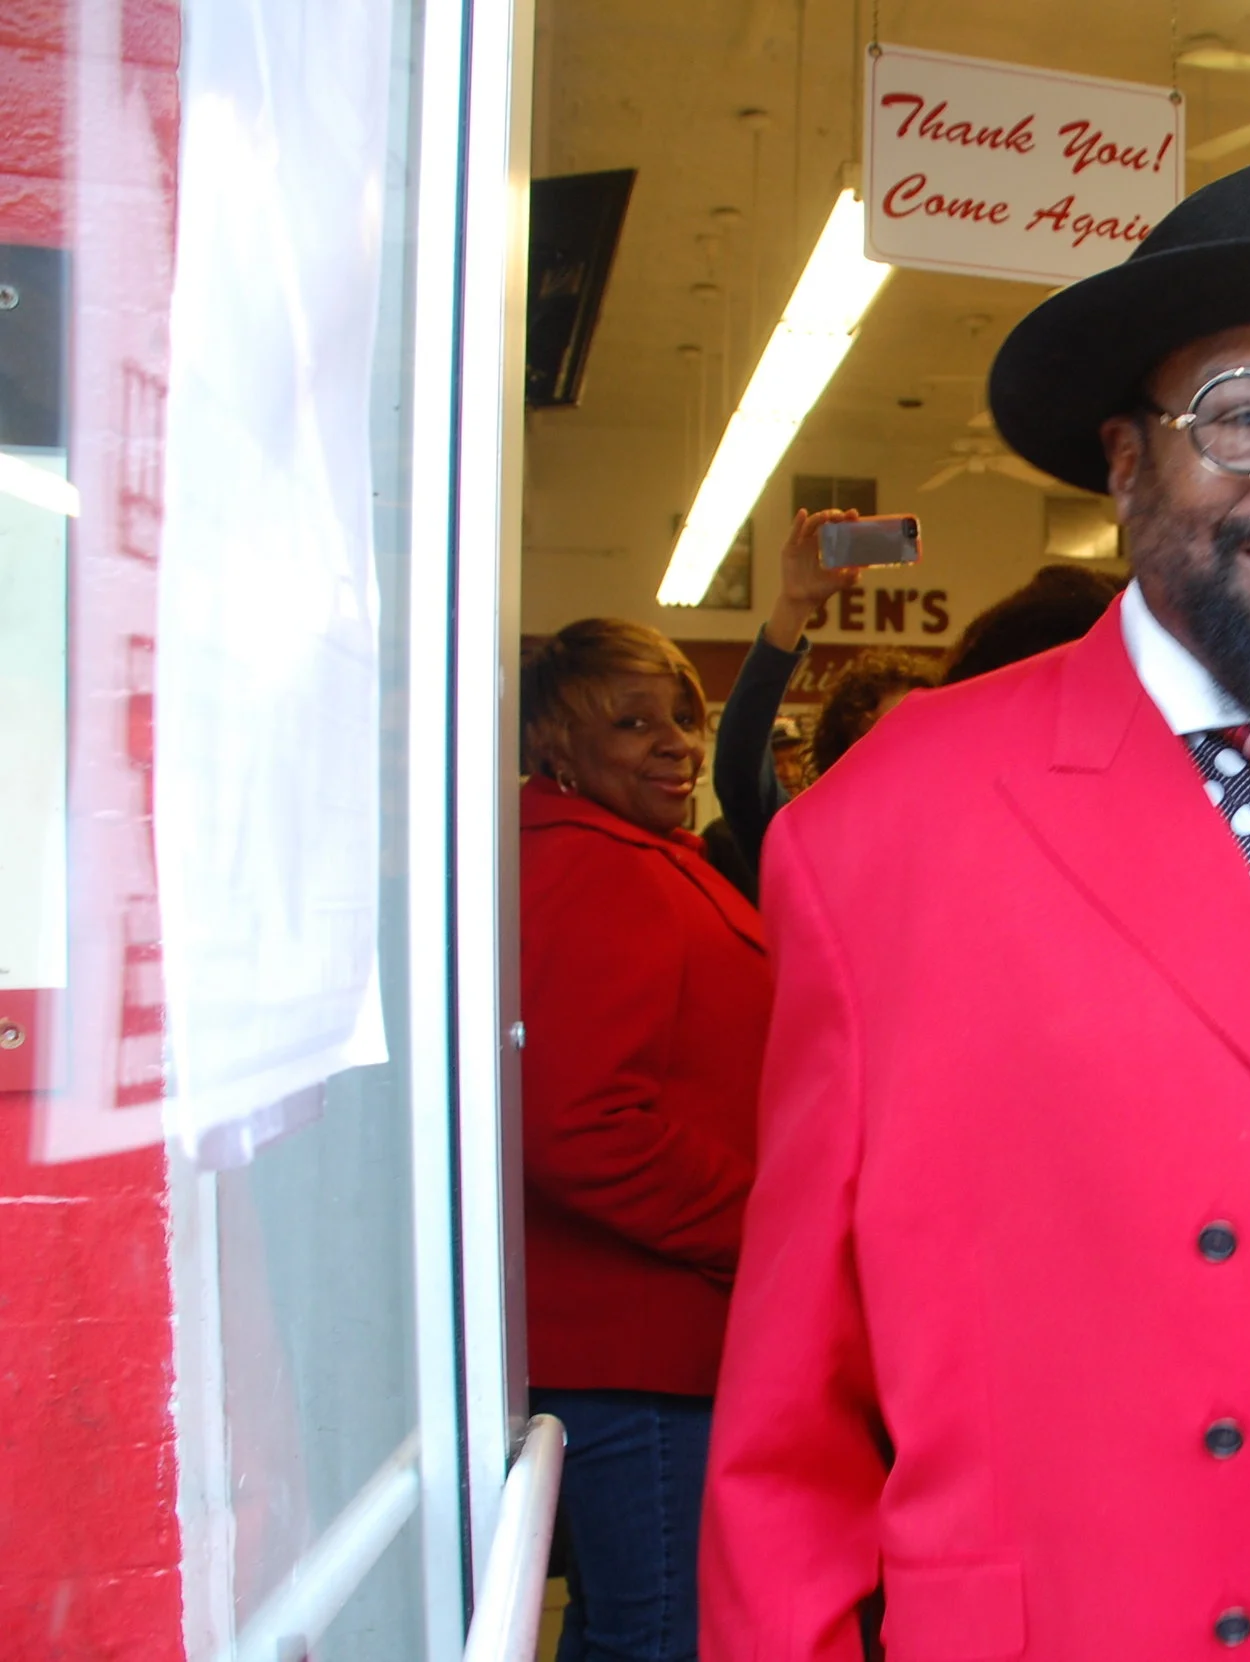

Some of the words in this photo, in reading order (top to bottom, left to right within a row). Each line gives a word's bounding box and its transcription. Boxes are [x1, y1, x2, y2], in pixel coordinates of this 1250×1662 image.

[881, 92, 1035, 154] Thank
[1058, 120, 1173, 175] You!
[882, 173, 1010, 226] Come
